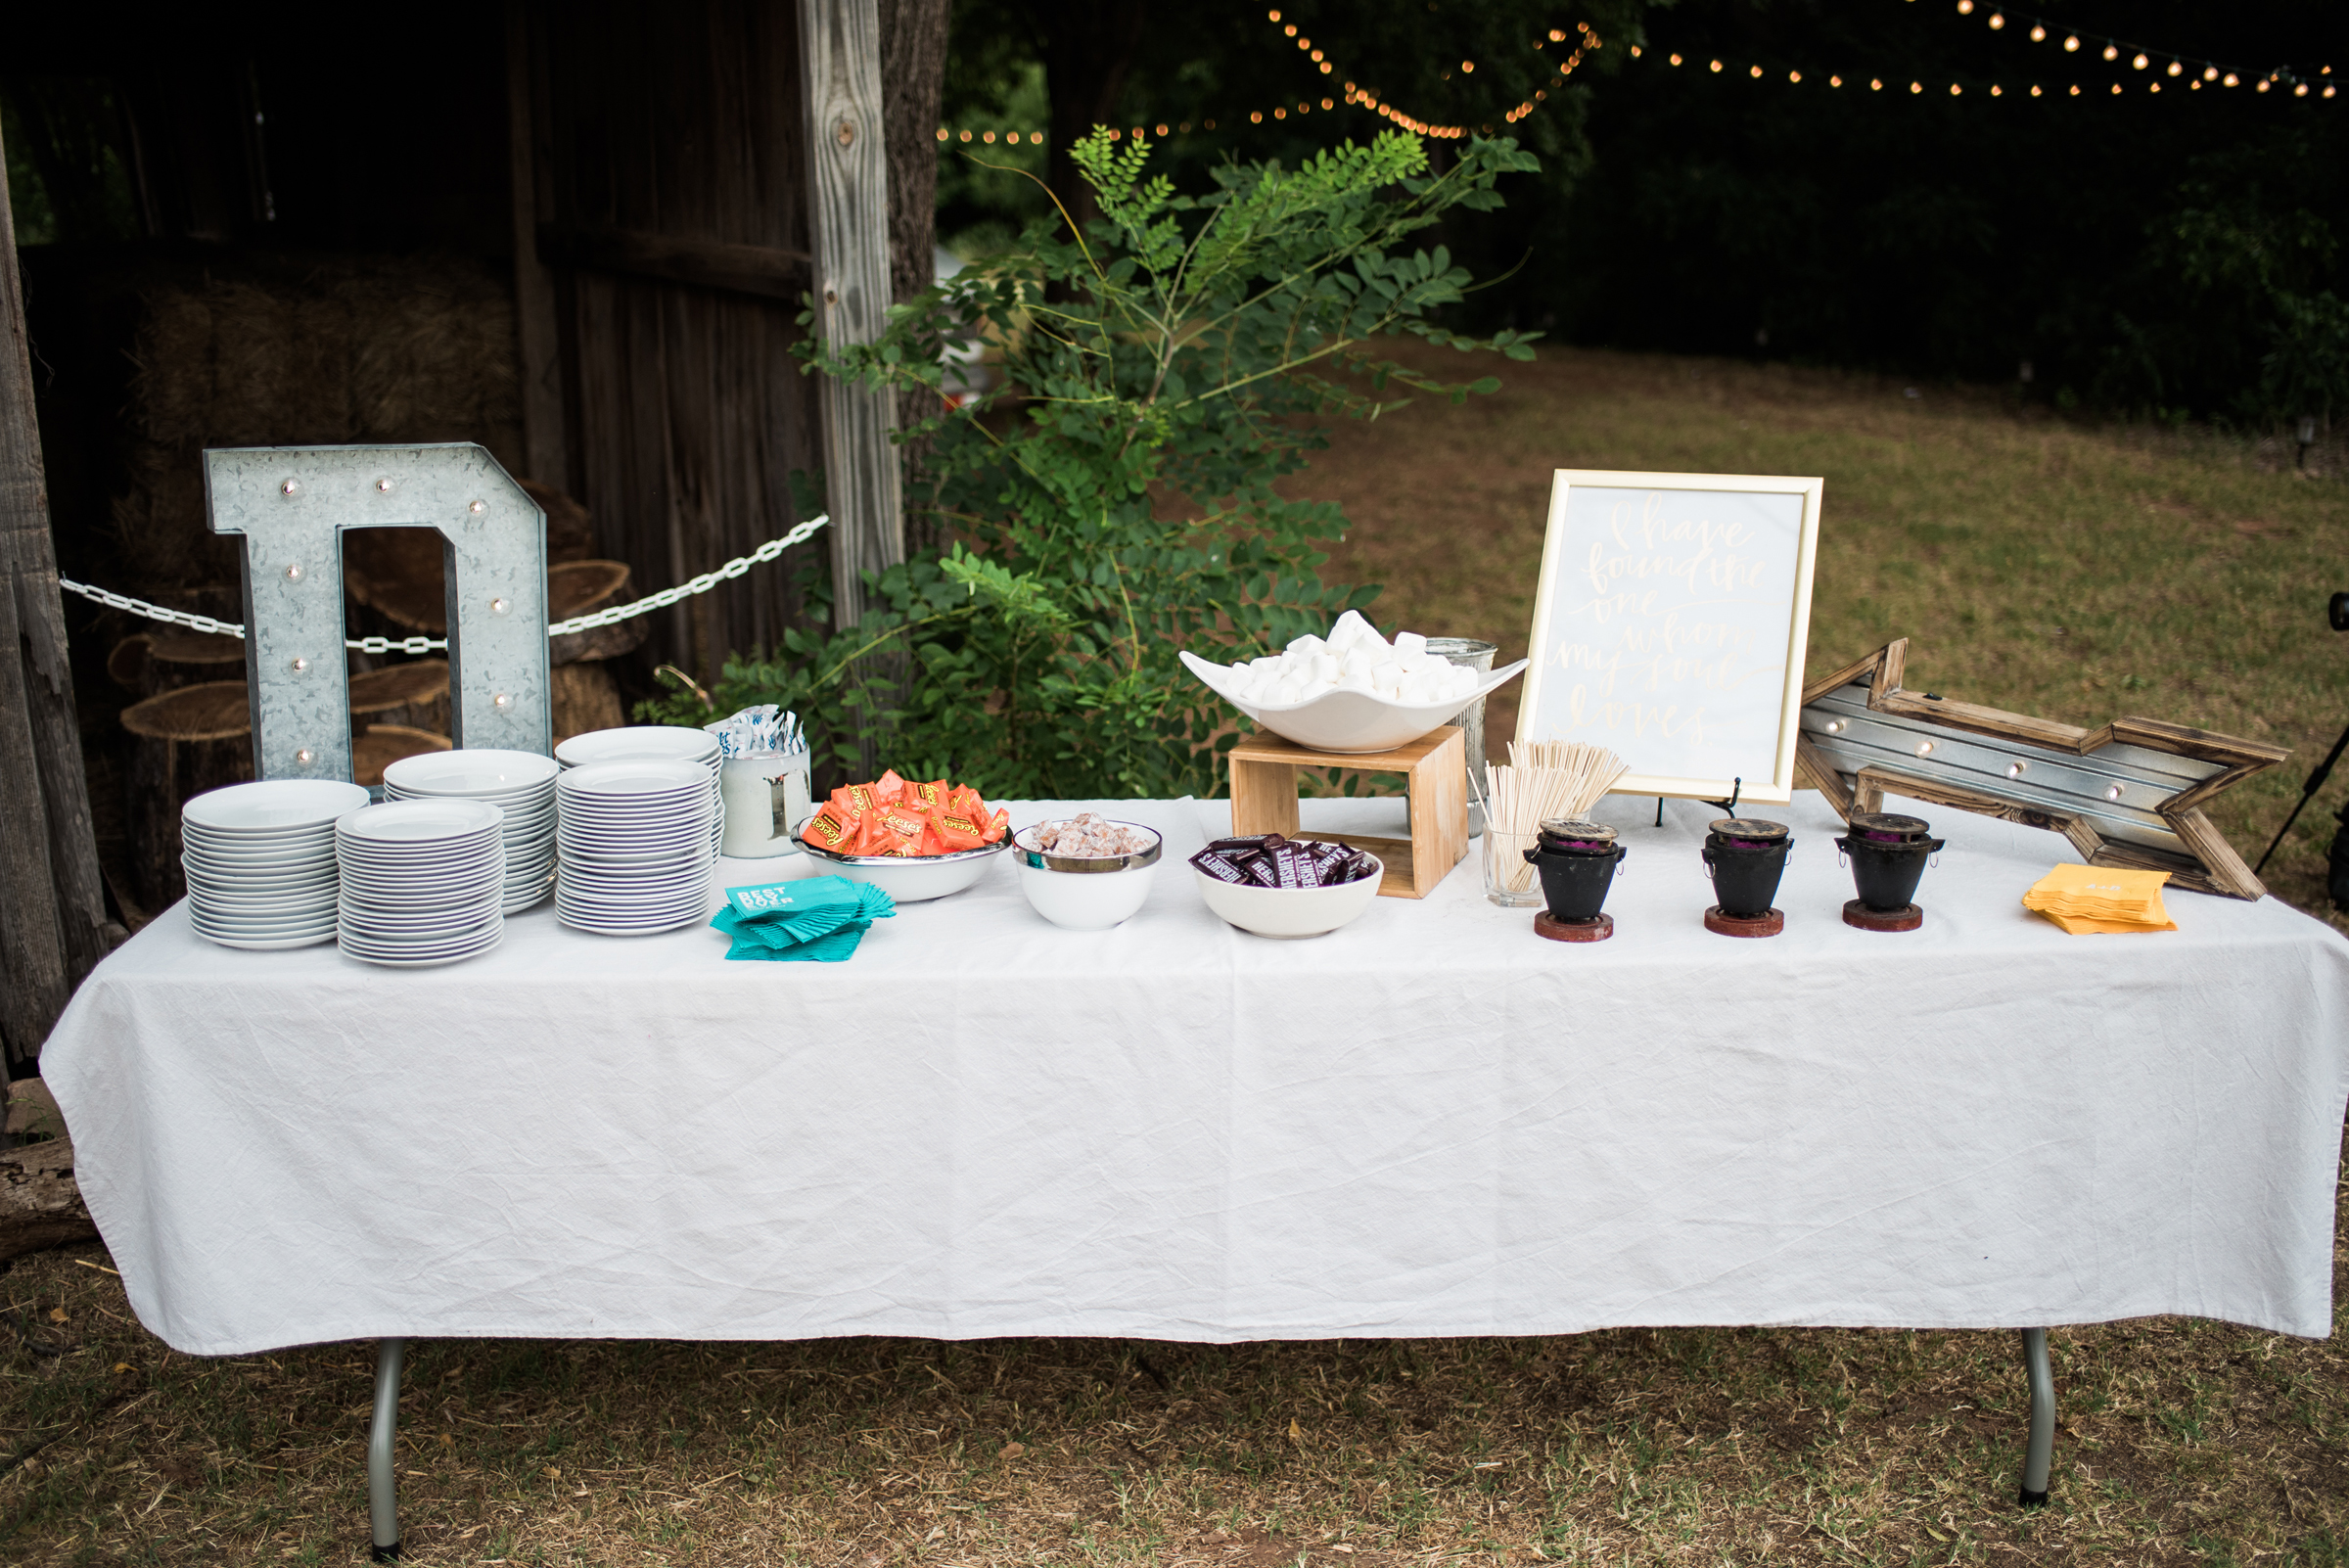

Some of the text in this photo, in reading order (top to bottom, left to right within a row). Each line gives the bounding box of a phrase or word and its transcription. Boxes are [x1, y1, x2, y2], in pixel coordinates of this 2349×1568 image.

[1610, 490, 1756, 552] I have
[1580, 541, 1768, 595] found the
[1614, 611, 1757, 655] whom
[1545, 640, 1785, 698] my soul
[811, 816, 844, 847] Reese's
[1198, 853, 1242, 884] HERSHEY'S
[1298, 853, 1318, 889] ERSHEY'S
[737, 887, 785, 899] BEST
